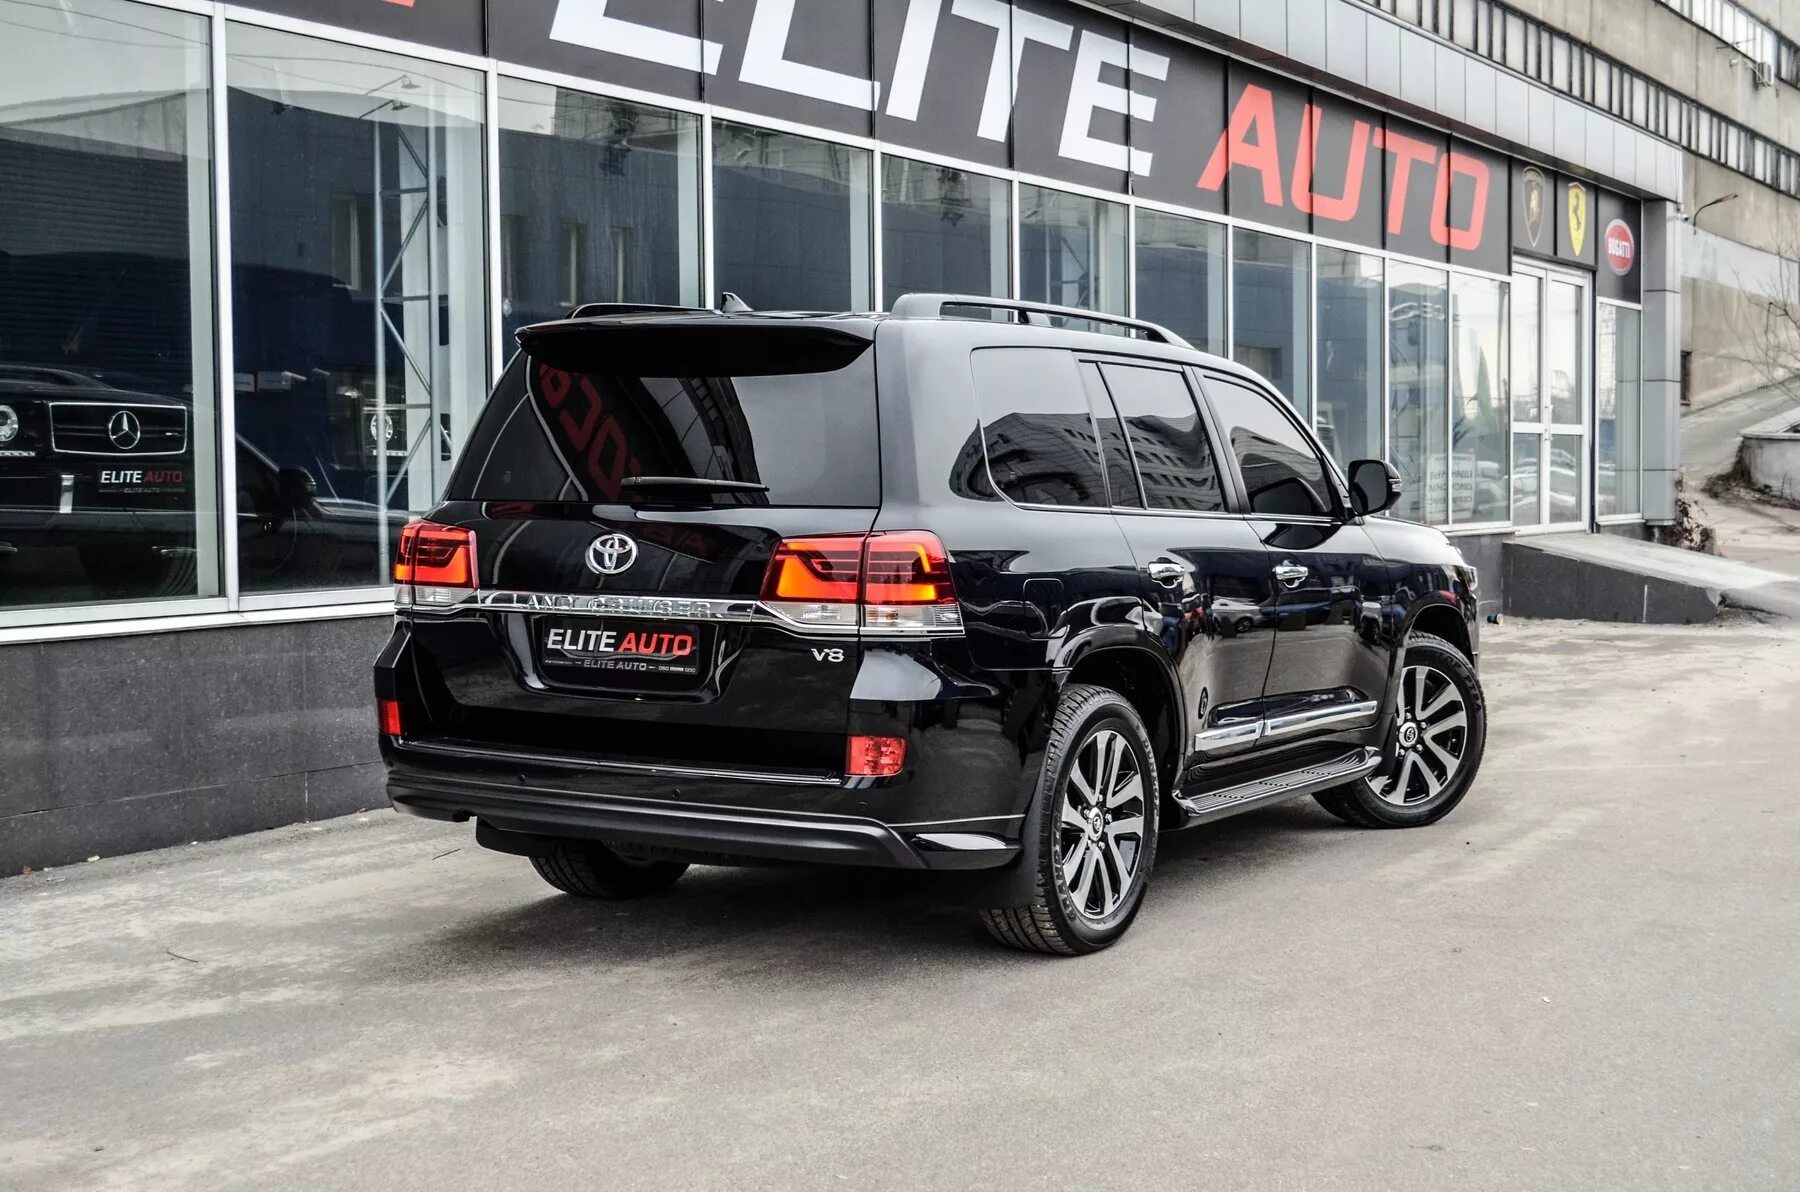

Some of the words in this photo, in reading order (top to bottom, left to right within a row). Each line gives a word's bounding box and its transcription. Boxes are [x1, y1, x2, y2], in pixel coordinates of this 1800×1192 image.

[1197, 83, 1490, 250] AUTO
[100, 470, 143, 484] ELITE
[143, 470, 183, 483] AUTO
[512, 592, 574, 611] LAND
[588, 596, 711, 618] CRUISER
[547, 628, 617, 652] ELITE
[618, 632, 693, 656] AUTO
[584, 659, 614, 669] ELITE
[616, 661, 647, 671] AUTO
[811, 648, 845, 662] V8
